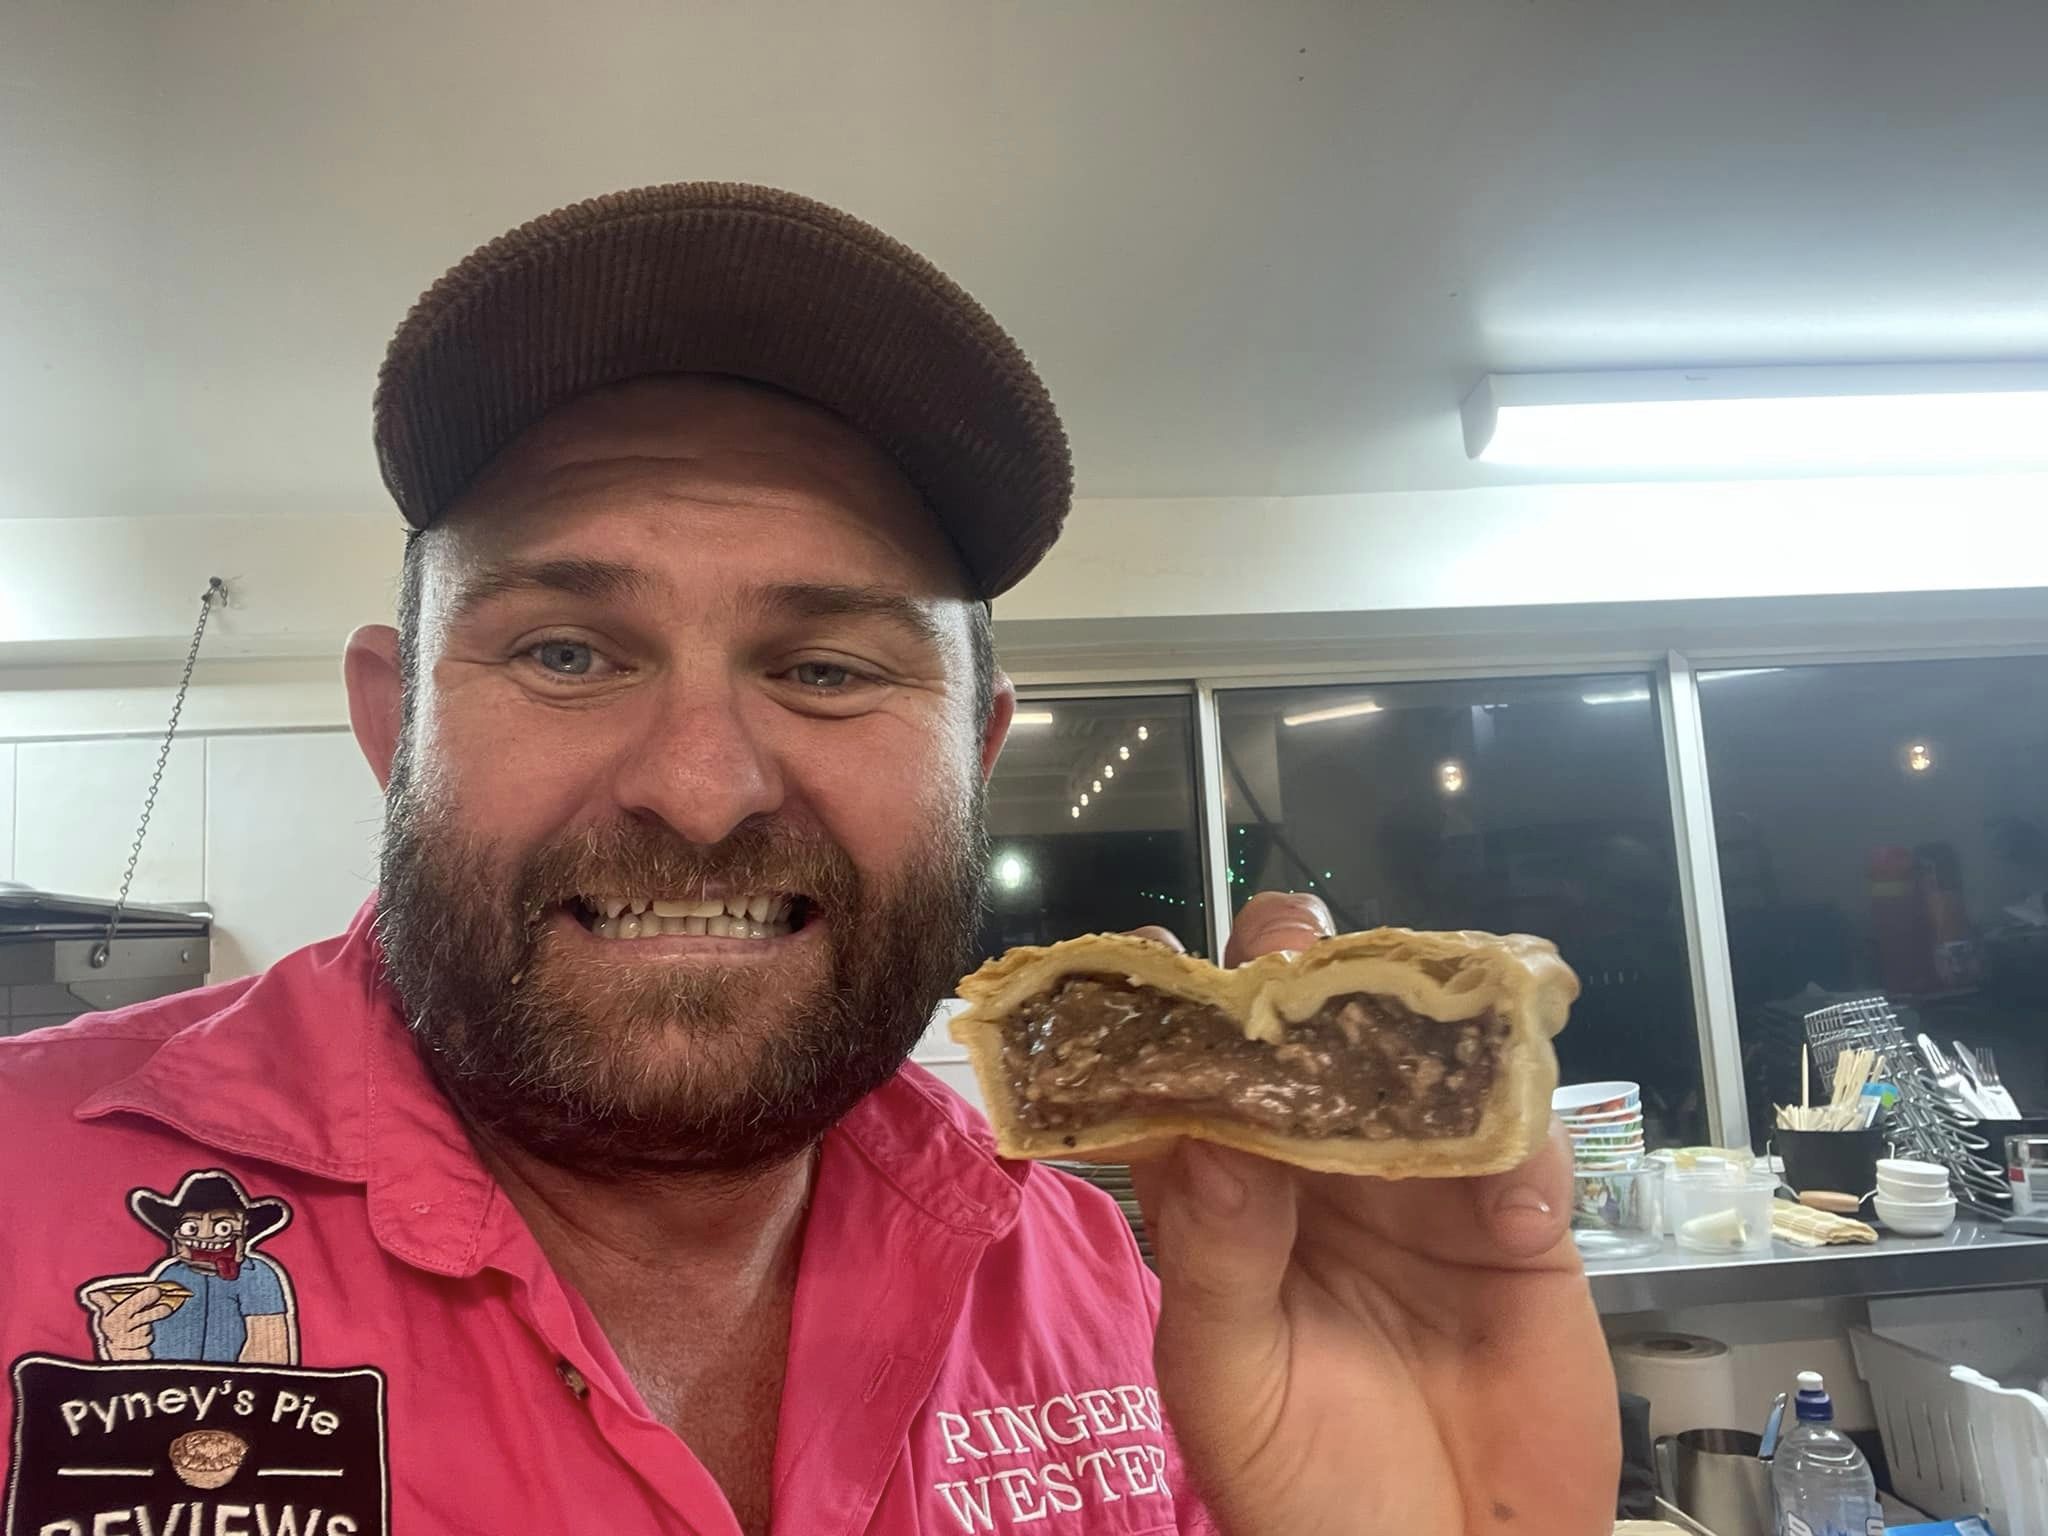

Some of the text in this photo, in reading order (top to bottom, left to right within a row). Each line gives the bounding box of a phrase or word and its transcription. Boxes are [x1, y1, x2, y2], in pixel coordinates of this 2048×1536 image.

[60, 1380, 340, 1437] Pyney's Pie
[39, 1501, 358, 1536] VIEW
